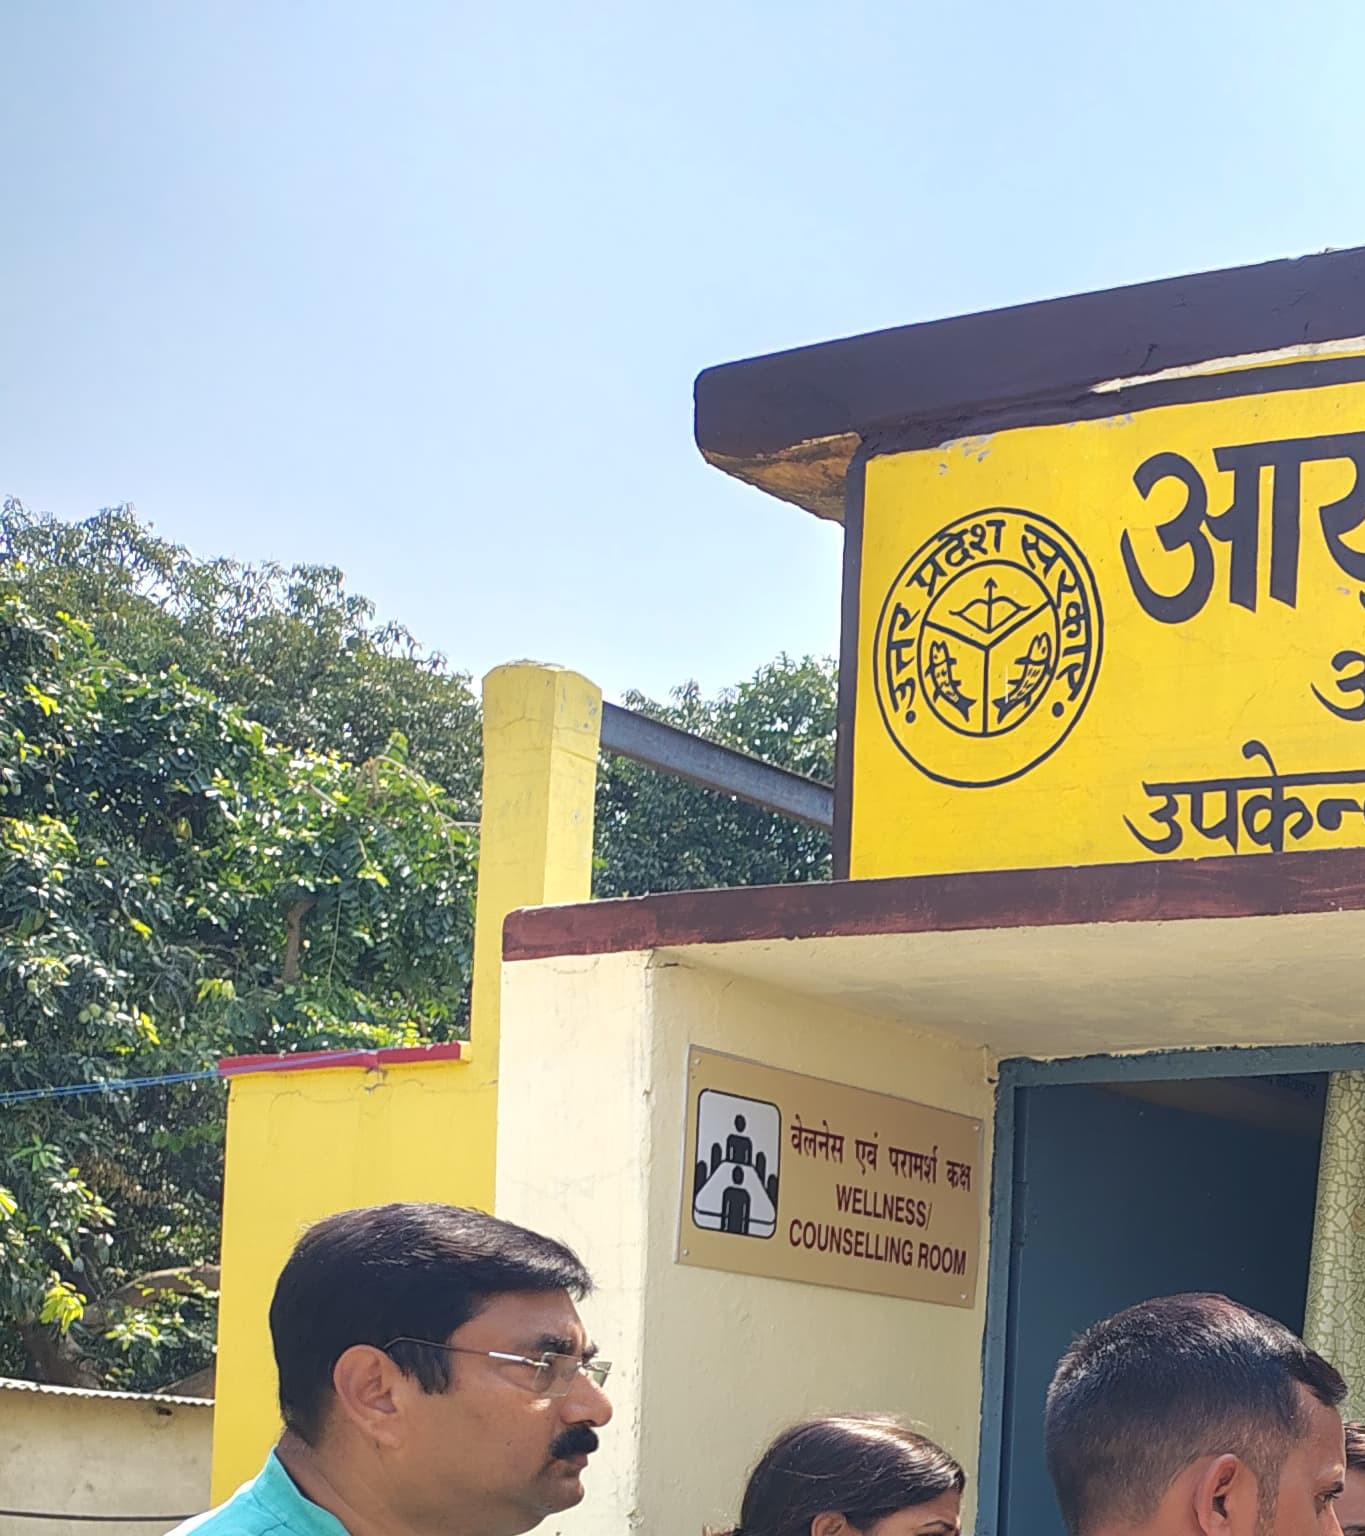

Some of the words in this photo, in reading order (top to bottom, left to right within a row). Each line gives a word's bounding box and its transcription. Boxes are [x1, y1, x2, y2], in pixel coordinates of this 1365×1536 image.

[905, 519, 1006, 597] प्रदेश
[1021, 523, 1092, 701] सरकार
[791, 1114, 845, 1163] वेलनेस
[855, 1132, 878, 1175] एवं
[888, 1145, 938, 1184] परामर्श
[946, 1160, 972, 1192] कक्ष
[836, 1184, 933, 1231] WELLNESS/
[789, 1219, 914, 1266] COUNSELLING
[918, 1242, 967, 1276] ROOM
